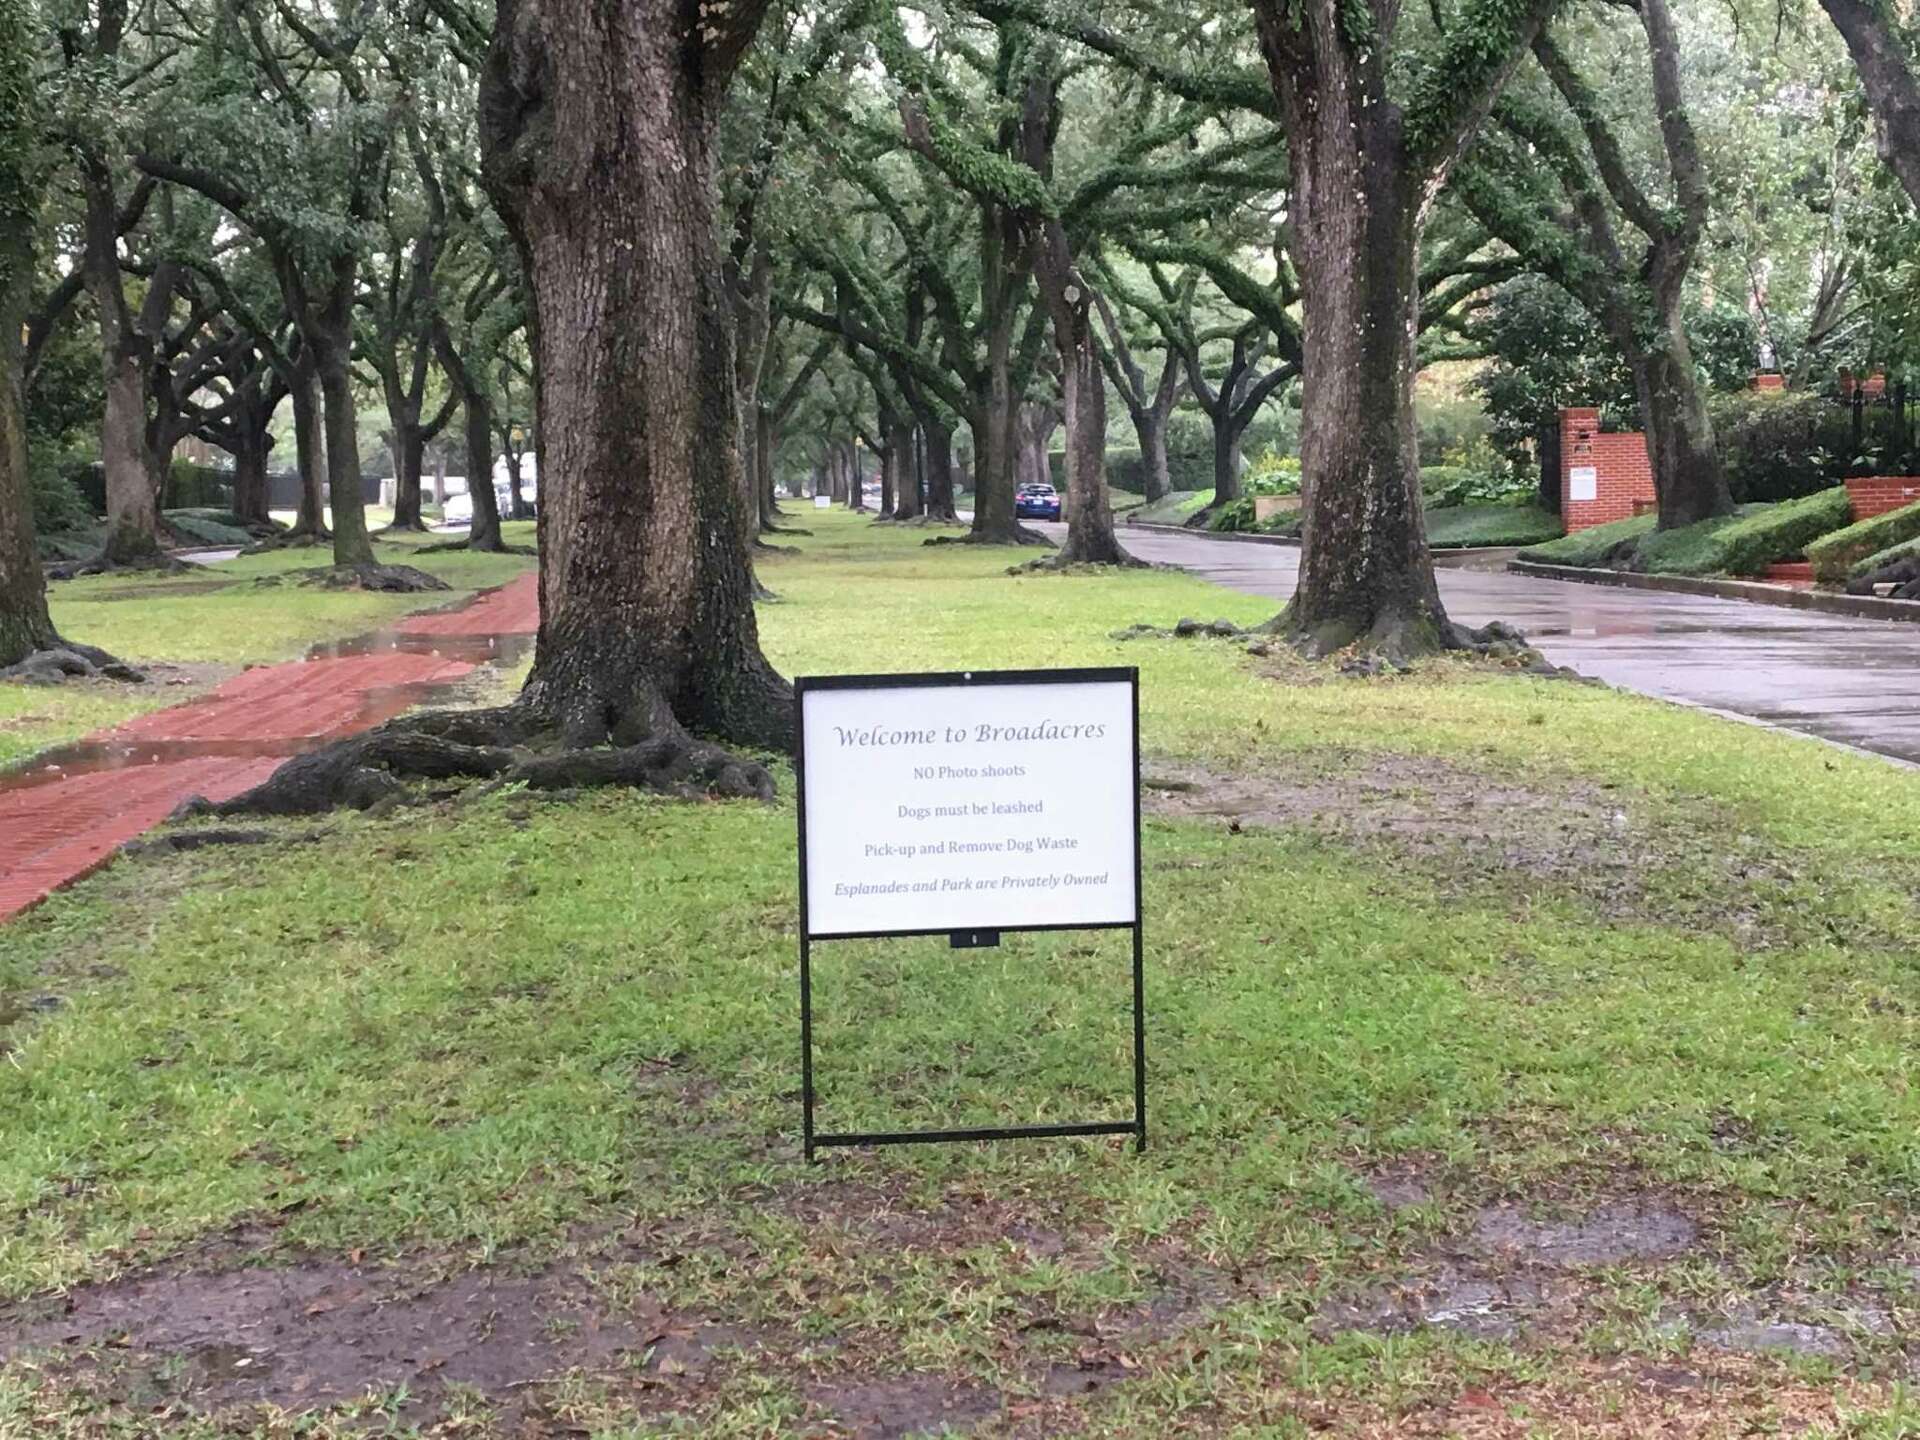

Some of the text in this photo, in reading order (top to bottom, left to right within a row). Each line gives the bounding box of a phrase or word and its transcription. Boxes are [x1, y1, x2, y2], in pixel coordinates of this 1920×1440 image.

[833, 719, 1106, 746] Welcome to Broadacres
[914, 765, 1025, 779] NO Photo shoots
[898, 800, 1043, 820] Dogs must be leashed
[865, 837, 1078, 858] Pick-up and Remove Dog Waste
[835, 872, 1108, 898] Esplanades and Park are Privately Owned
